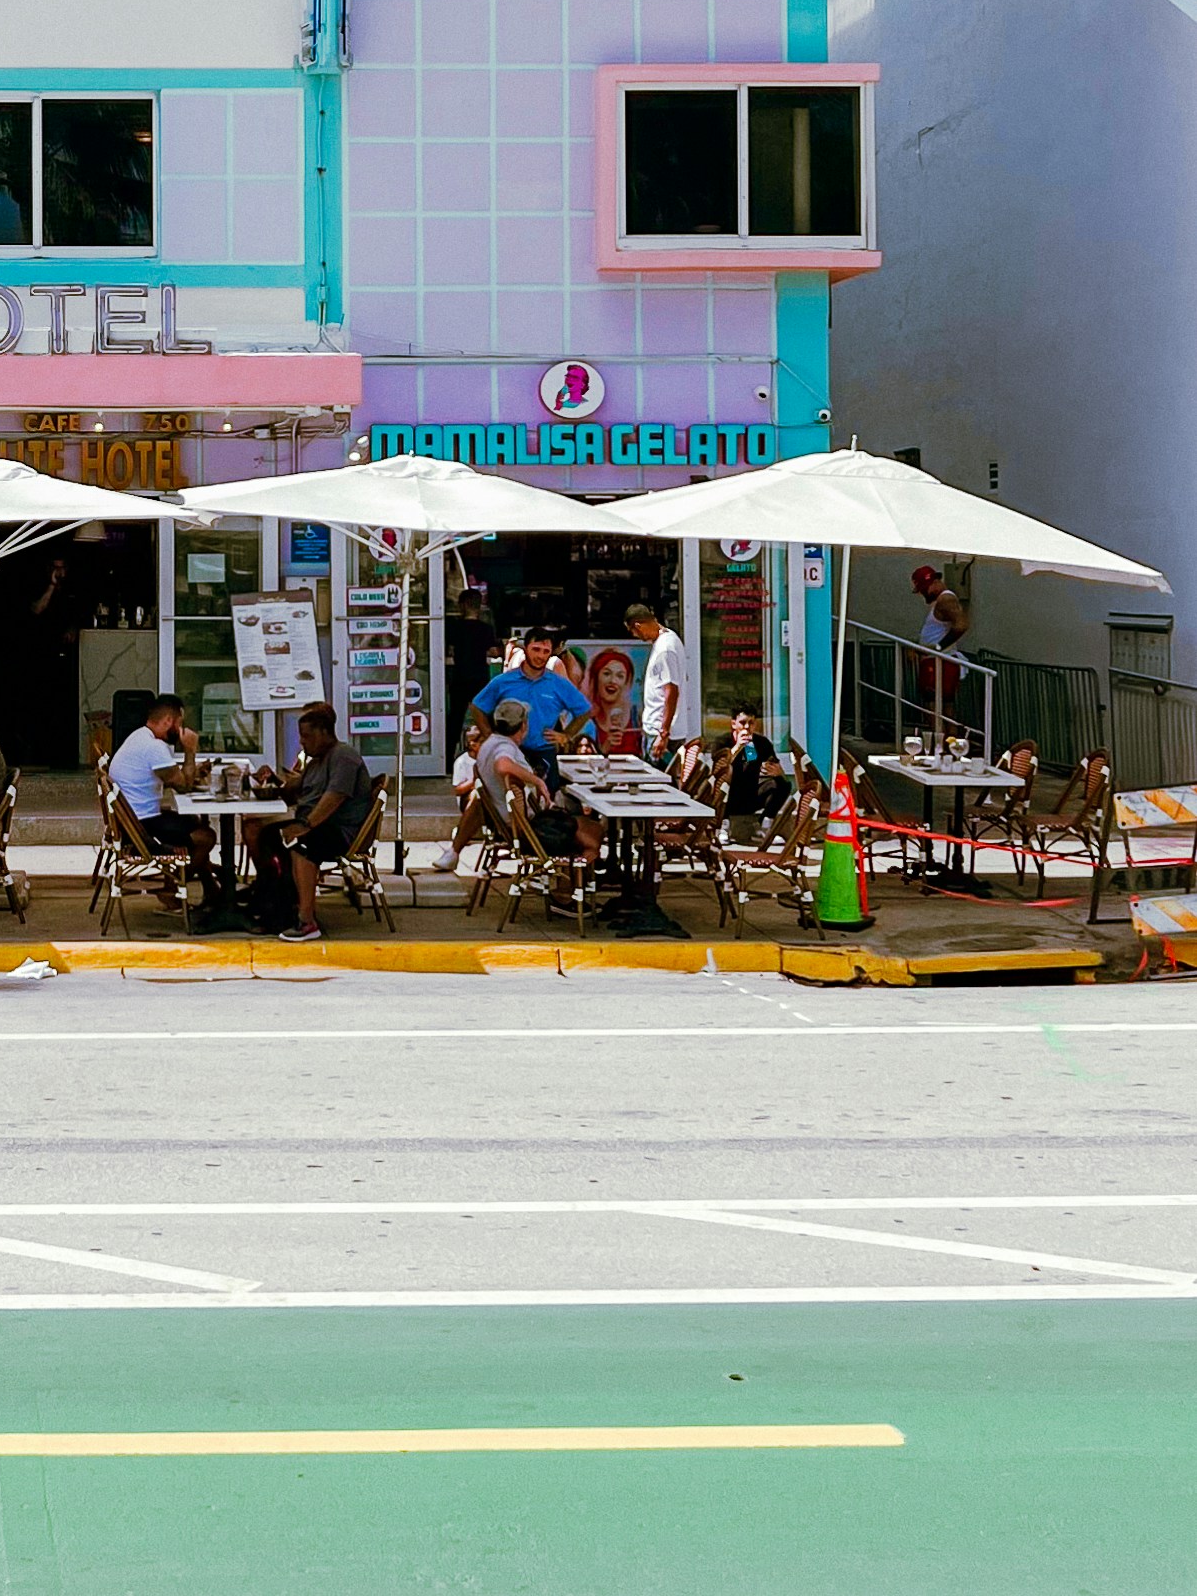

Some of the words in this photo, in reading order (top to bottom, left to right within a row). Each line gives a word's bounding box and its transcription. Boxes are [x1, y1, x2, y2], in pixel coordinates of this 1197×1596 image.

[24, 414, 80, 432] CAFE
[143, 414, 190, 432] 750
[370, 423, 603, 465] MAMALISA
[610, 423, 776, 465] GELATO
[80, 439, 190, 491] HOTEL
